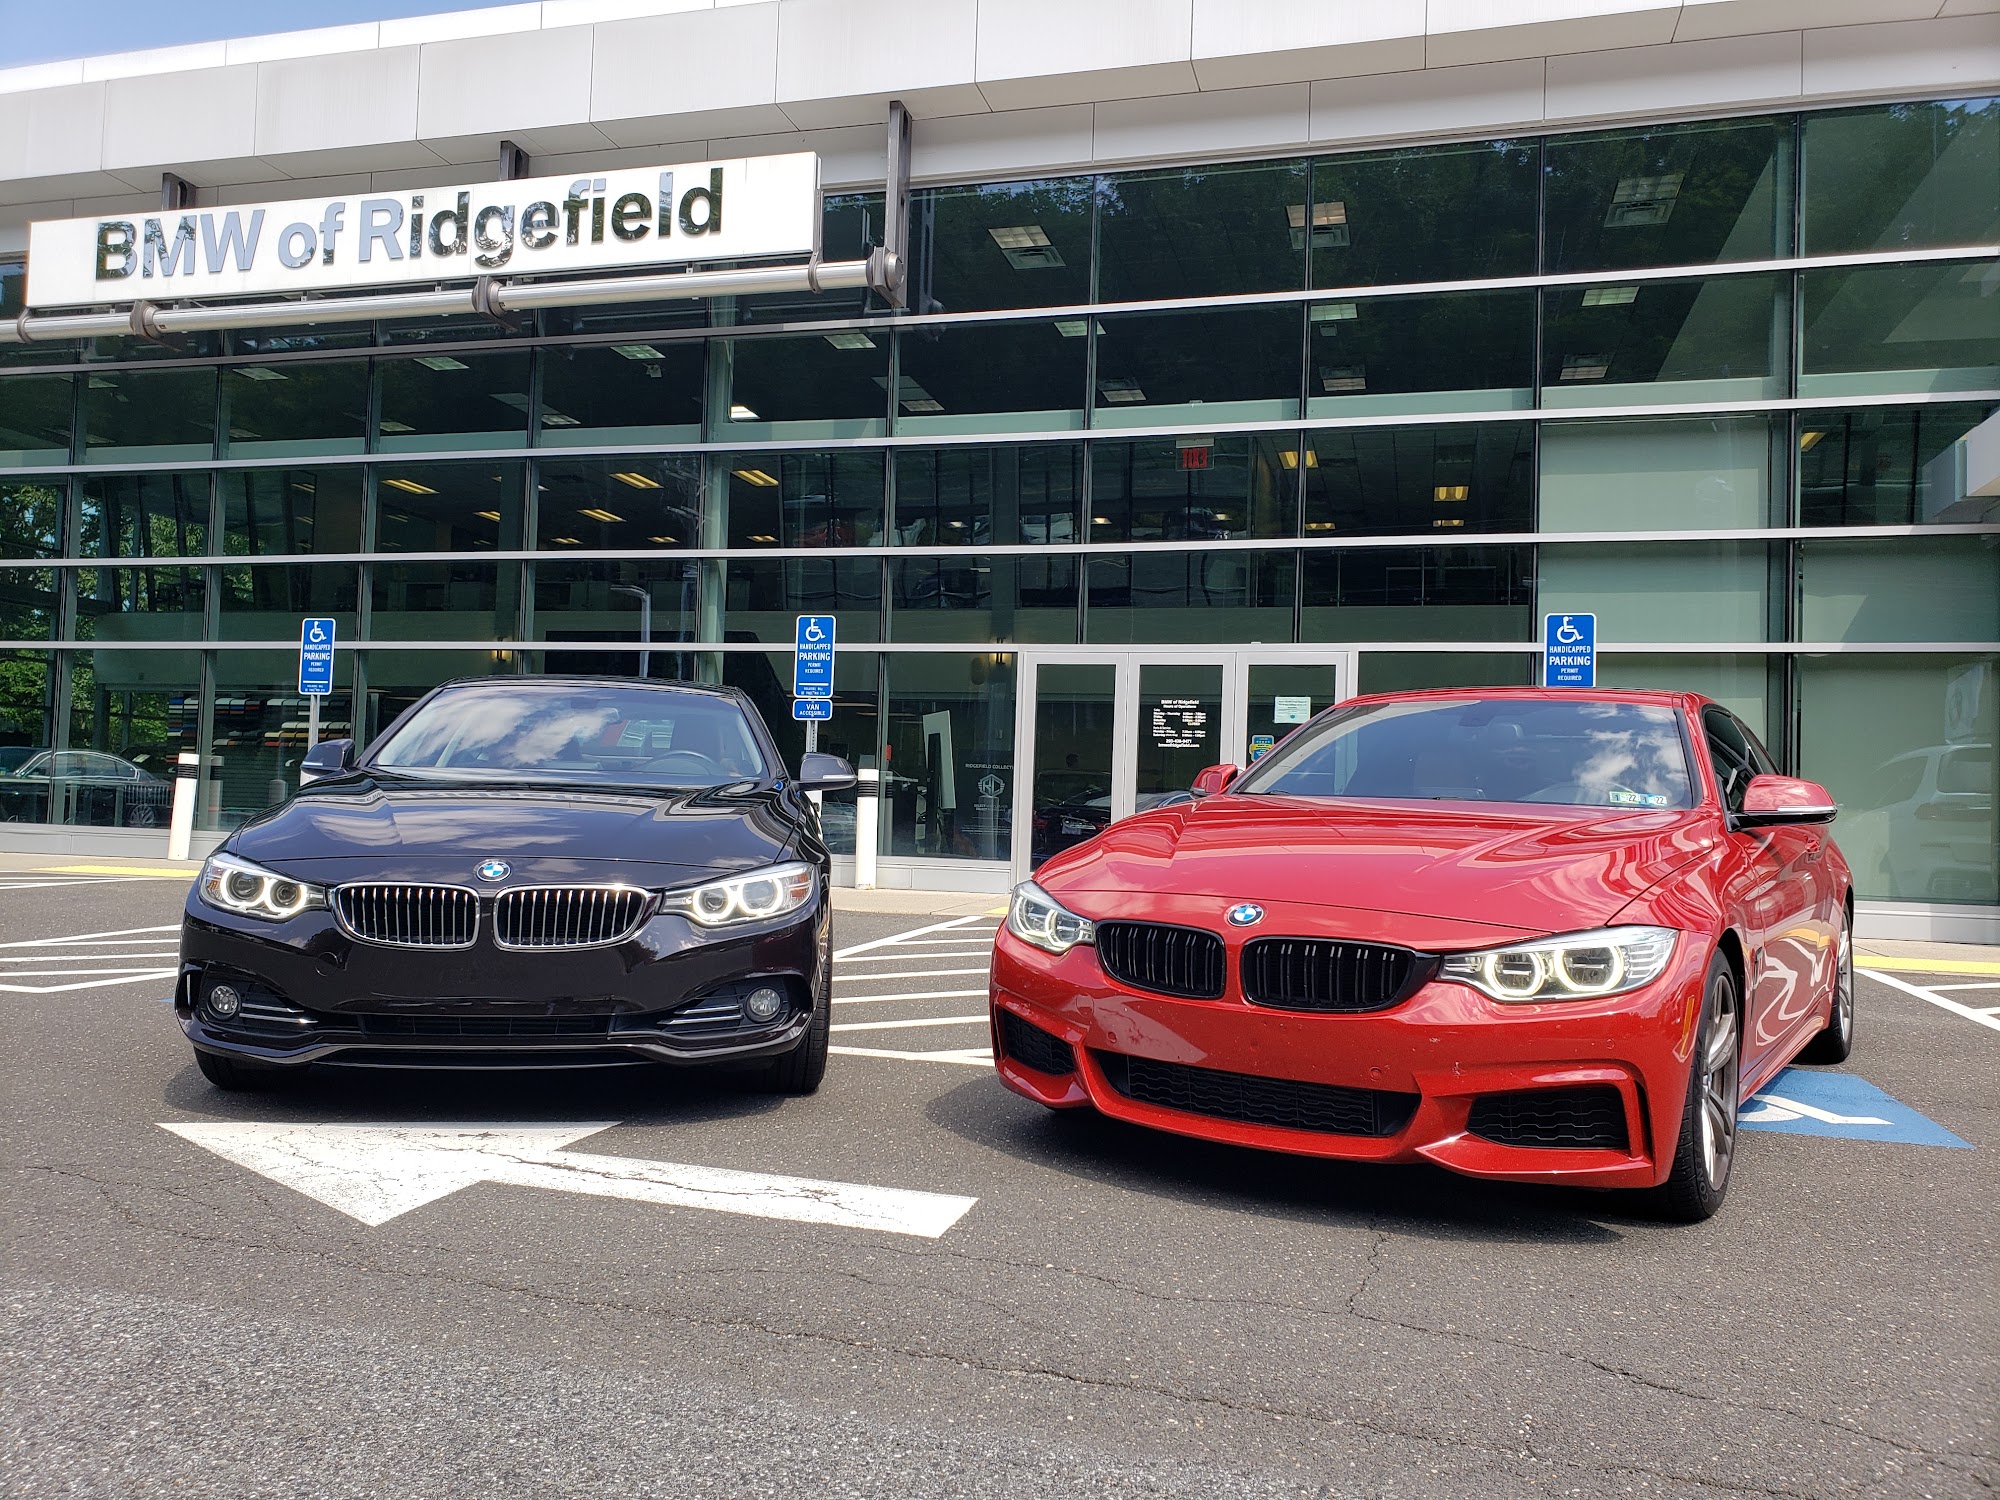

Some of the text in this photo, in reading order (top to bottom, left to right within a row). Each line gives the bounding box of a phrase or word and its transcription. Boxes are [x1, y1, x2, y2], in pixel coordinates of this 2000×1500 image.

[96, 167, 724, 281] BMW of Ridgefield
[1549, 645, 1591, 653] HANDICAPPED
[303, 652, 331, 661] PARKING
[799, 652, 831, 661] PARKING
[1549, 656, 1591, 666] PARKING
[806, 703, 820, 711] VAN
